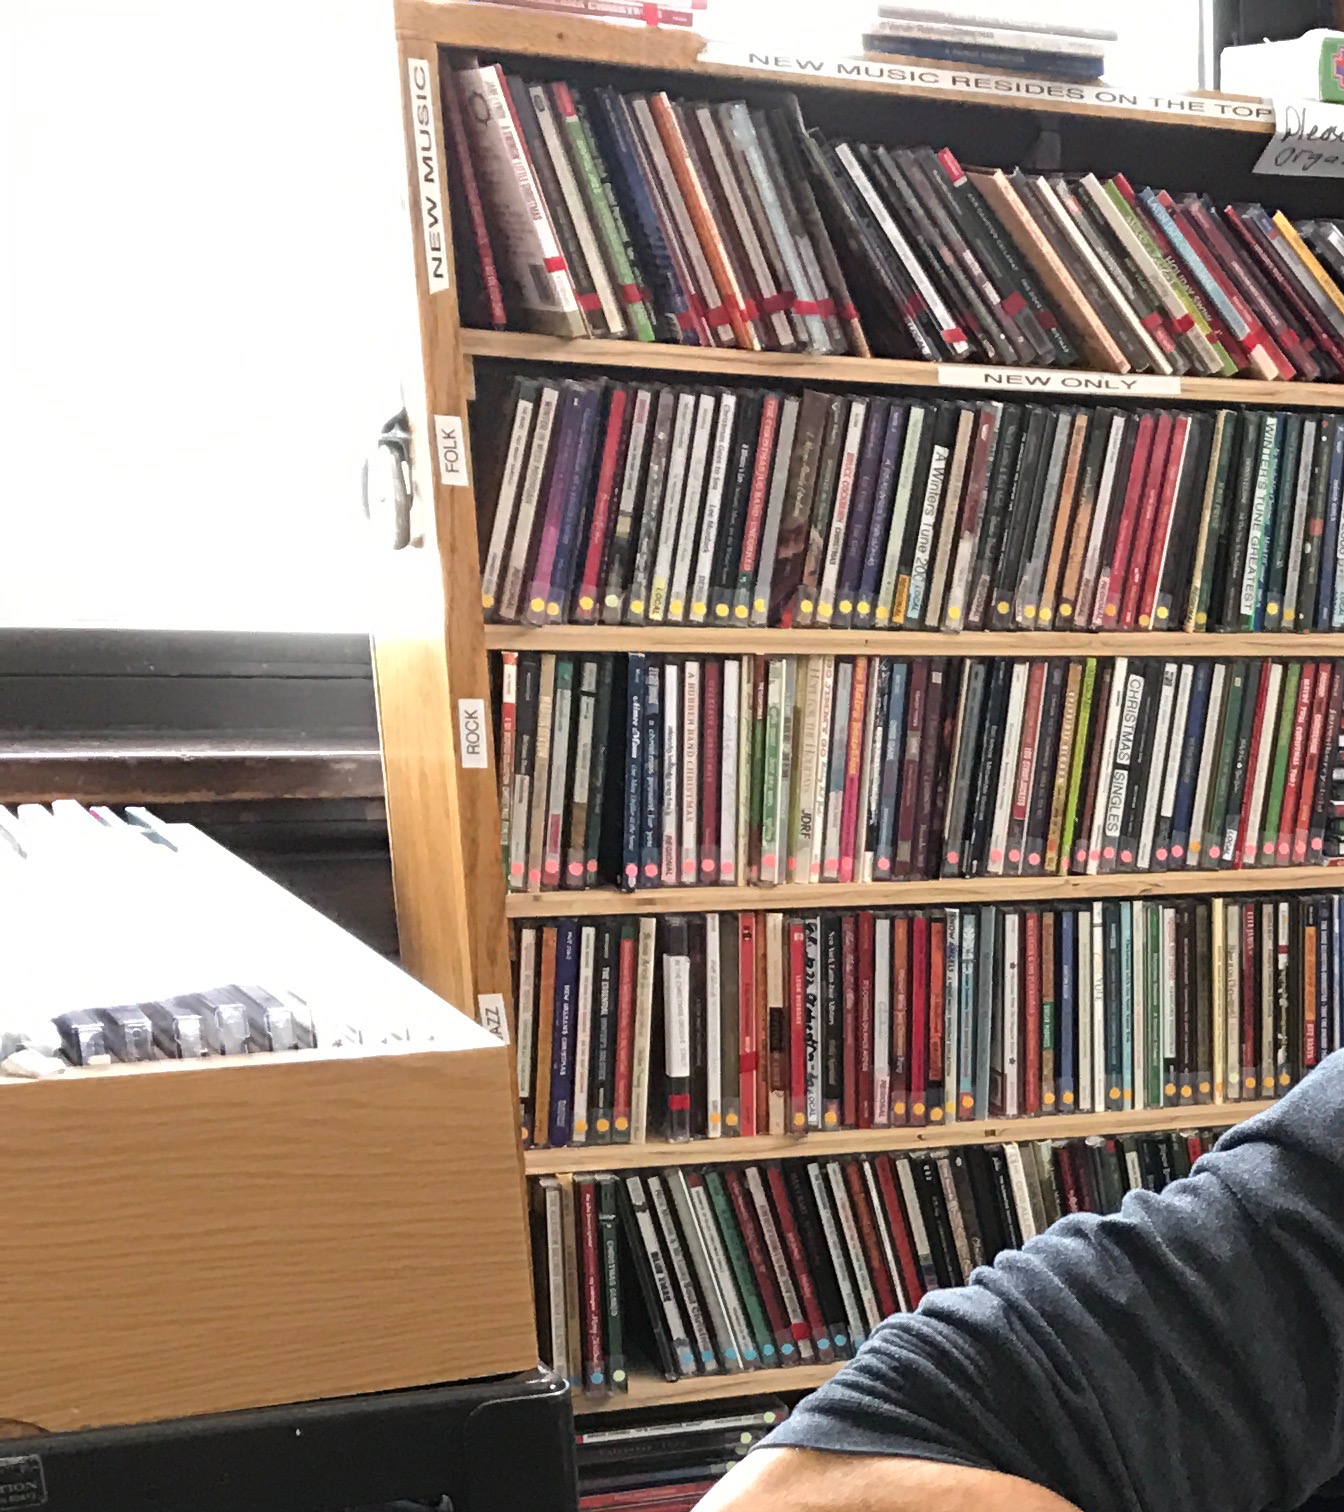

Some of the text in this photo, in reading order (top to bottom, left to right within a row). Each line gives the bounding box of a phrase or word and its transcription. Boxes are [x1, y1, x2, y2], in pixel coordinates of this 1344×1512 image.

[748, 53, 1273, 119] NEW MUSIC RESIDES ON THE TOP
[1285, 106, 1344, 143] Please
[415, 66, 445, 279] NEW MUSIC
[984, 373, 1137, 390] NEW ONLY
[718, 404, 731, 442] Christmas
[445, 428, 460, 473] FOLK
[707, 505, 717, 518] Lee
[918, 452, 947, 554] A Winters Tune
[1252, 496, 1265, 532] TUNE
[1243, 536, 1260, 611] GREATEST
[652, 587, 664, 615] LOCAL
[911, 585, 921, 611] LOCAL
[687, 682, 695, 725] RUBBER
[465, 709, 481, 755] ROCK
[686, 729, 694, 757] BAND
[1106, 678, 1142, 833] CHRISTMAS SINGLES
[685, 761, 694, 823] CHRISTMAS
[800, 809, 812, 839] JDRF
[1224, 830, 1236, 858] LOCAL
[485, 1006, 503, 1040] AZZ
